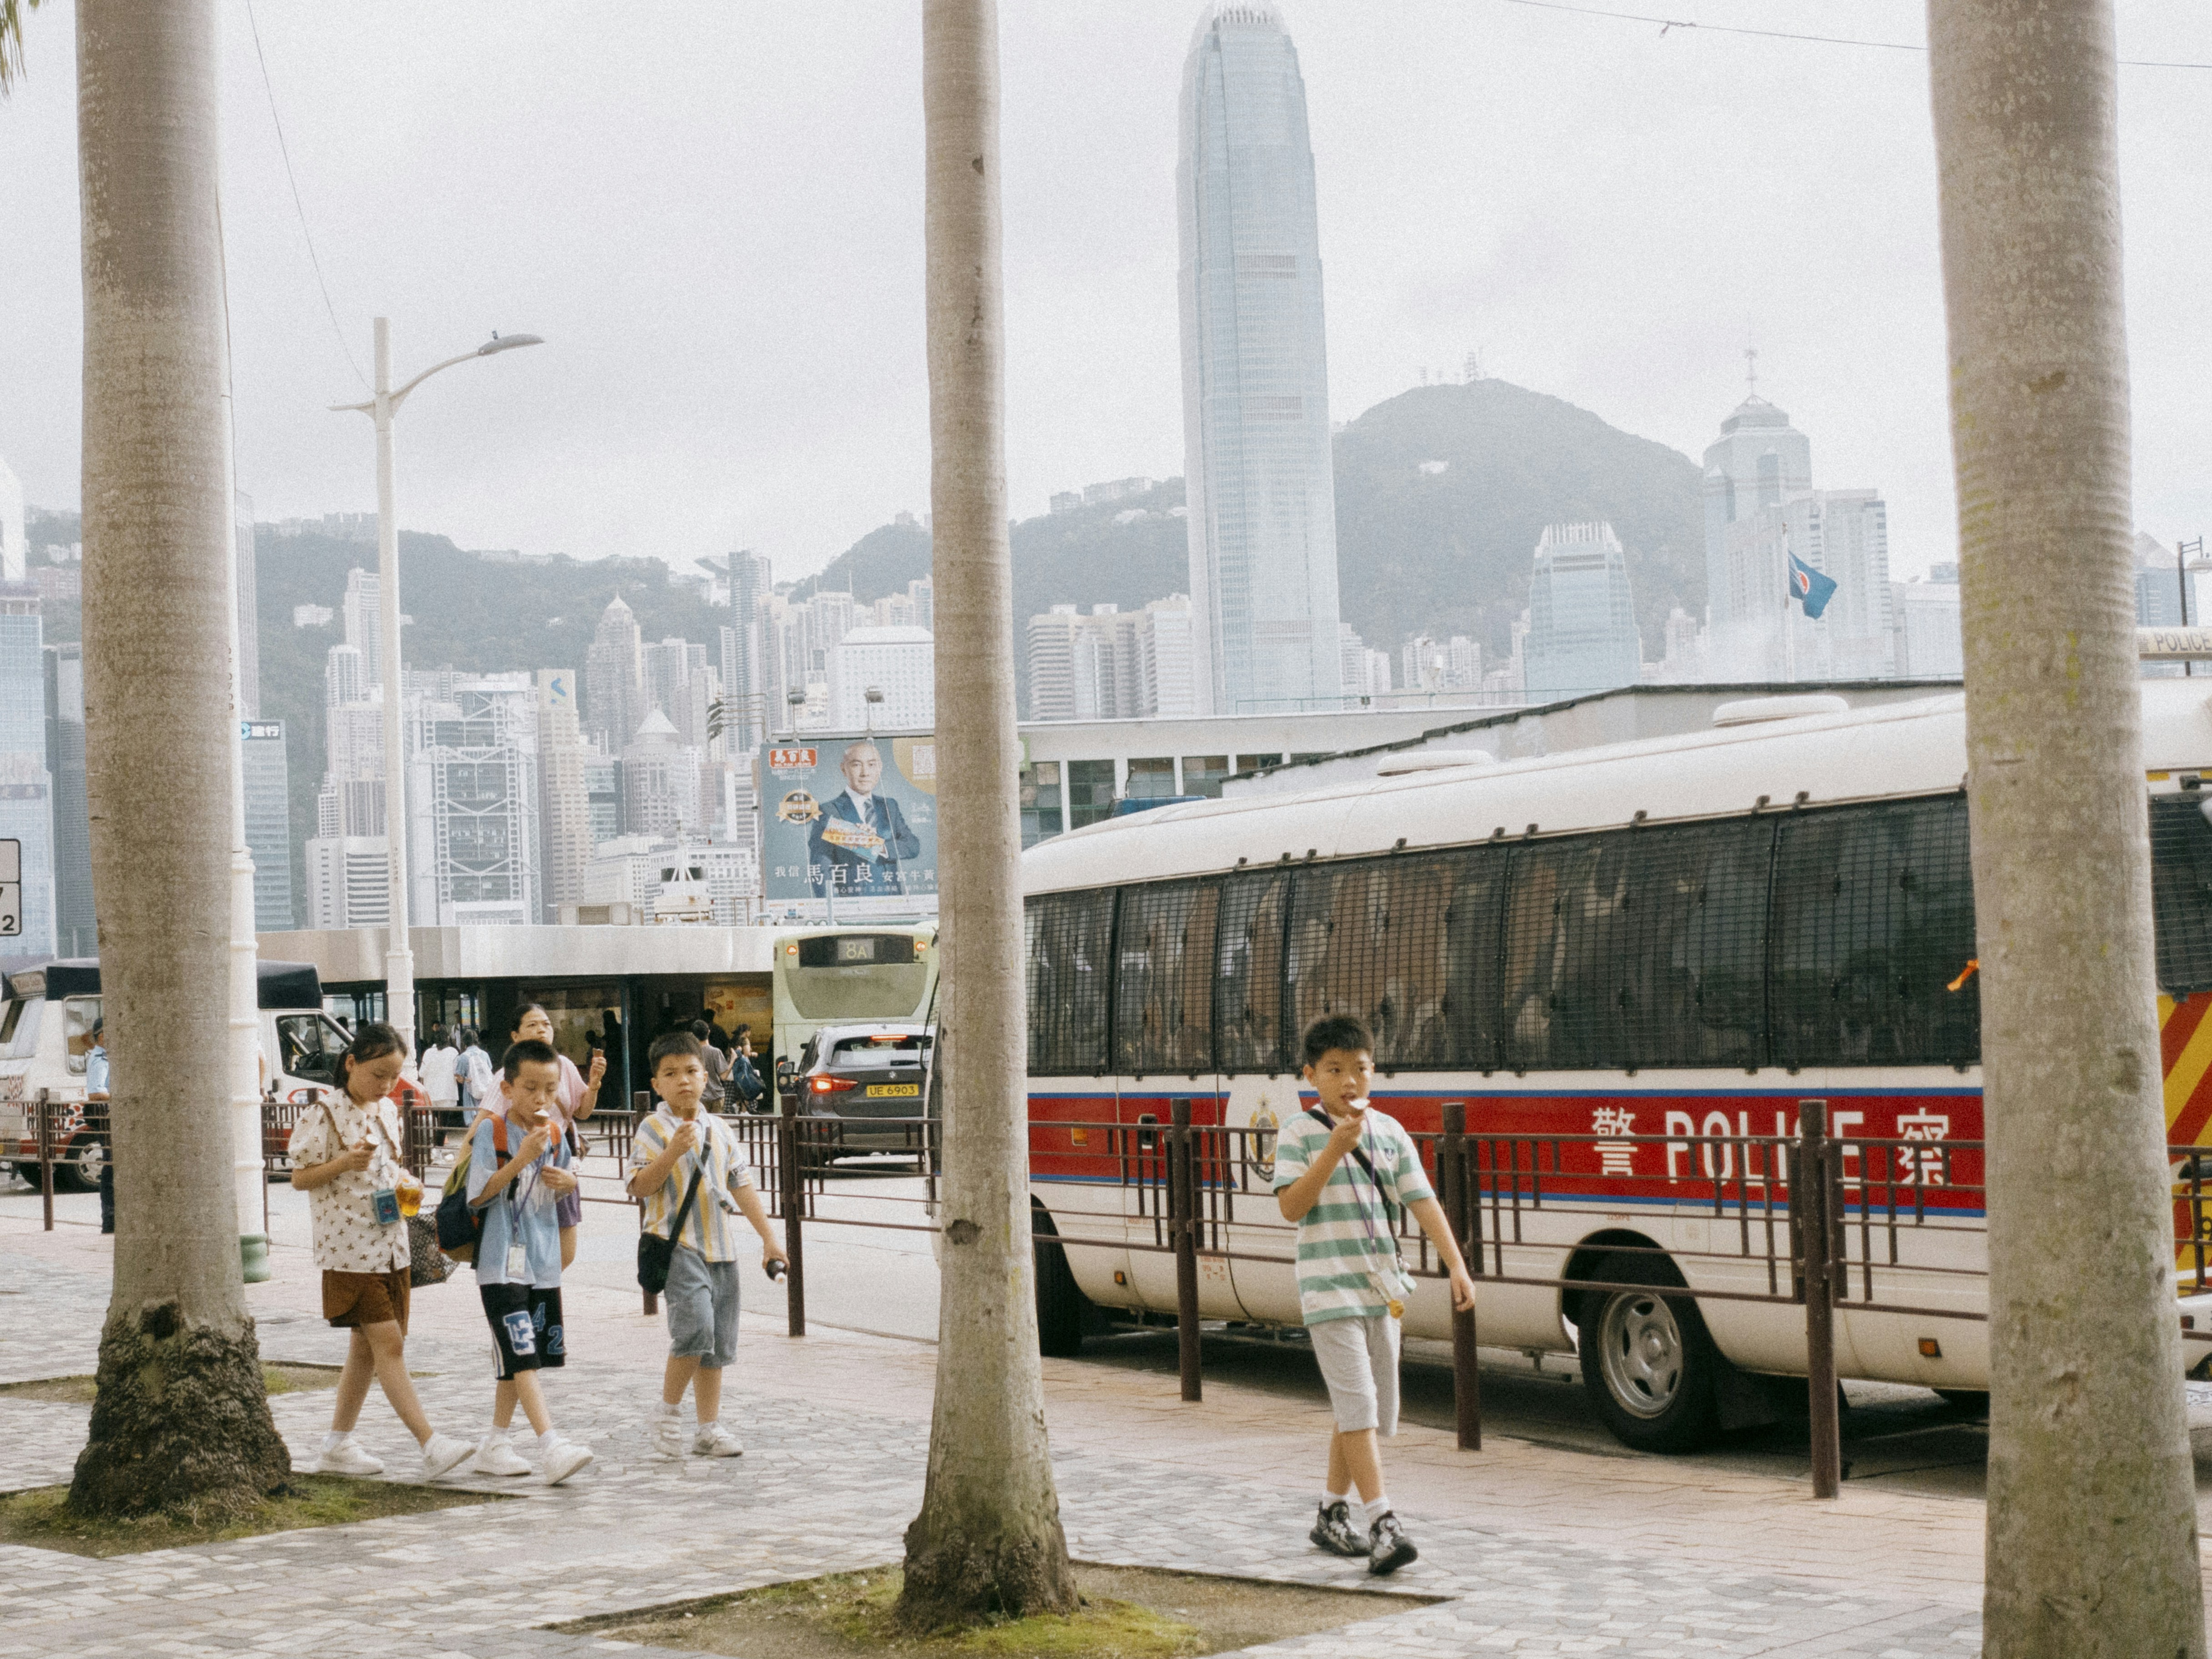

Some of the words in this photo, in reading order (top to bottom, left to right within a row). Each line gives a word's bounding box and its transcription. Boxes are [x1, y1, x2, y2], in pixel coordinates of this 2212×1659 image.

[251, 725, 280, 737] 建行
[774, 865, 799, 877] 我信
[804, 862, 874, 885] 馬百良
[846, 941, 867, 959] 8A
[870, 1086, 883, 1096] UE
[887, 1086, 915, 1095] 6903
[1592, 1106, 1638, 1177] 警
[1665, 1110, 1864, 1190] POLIE
[1895, 1106, 1951, 1187] 察
